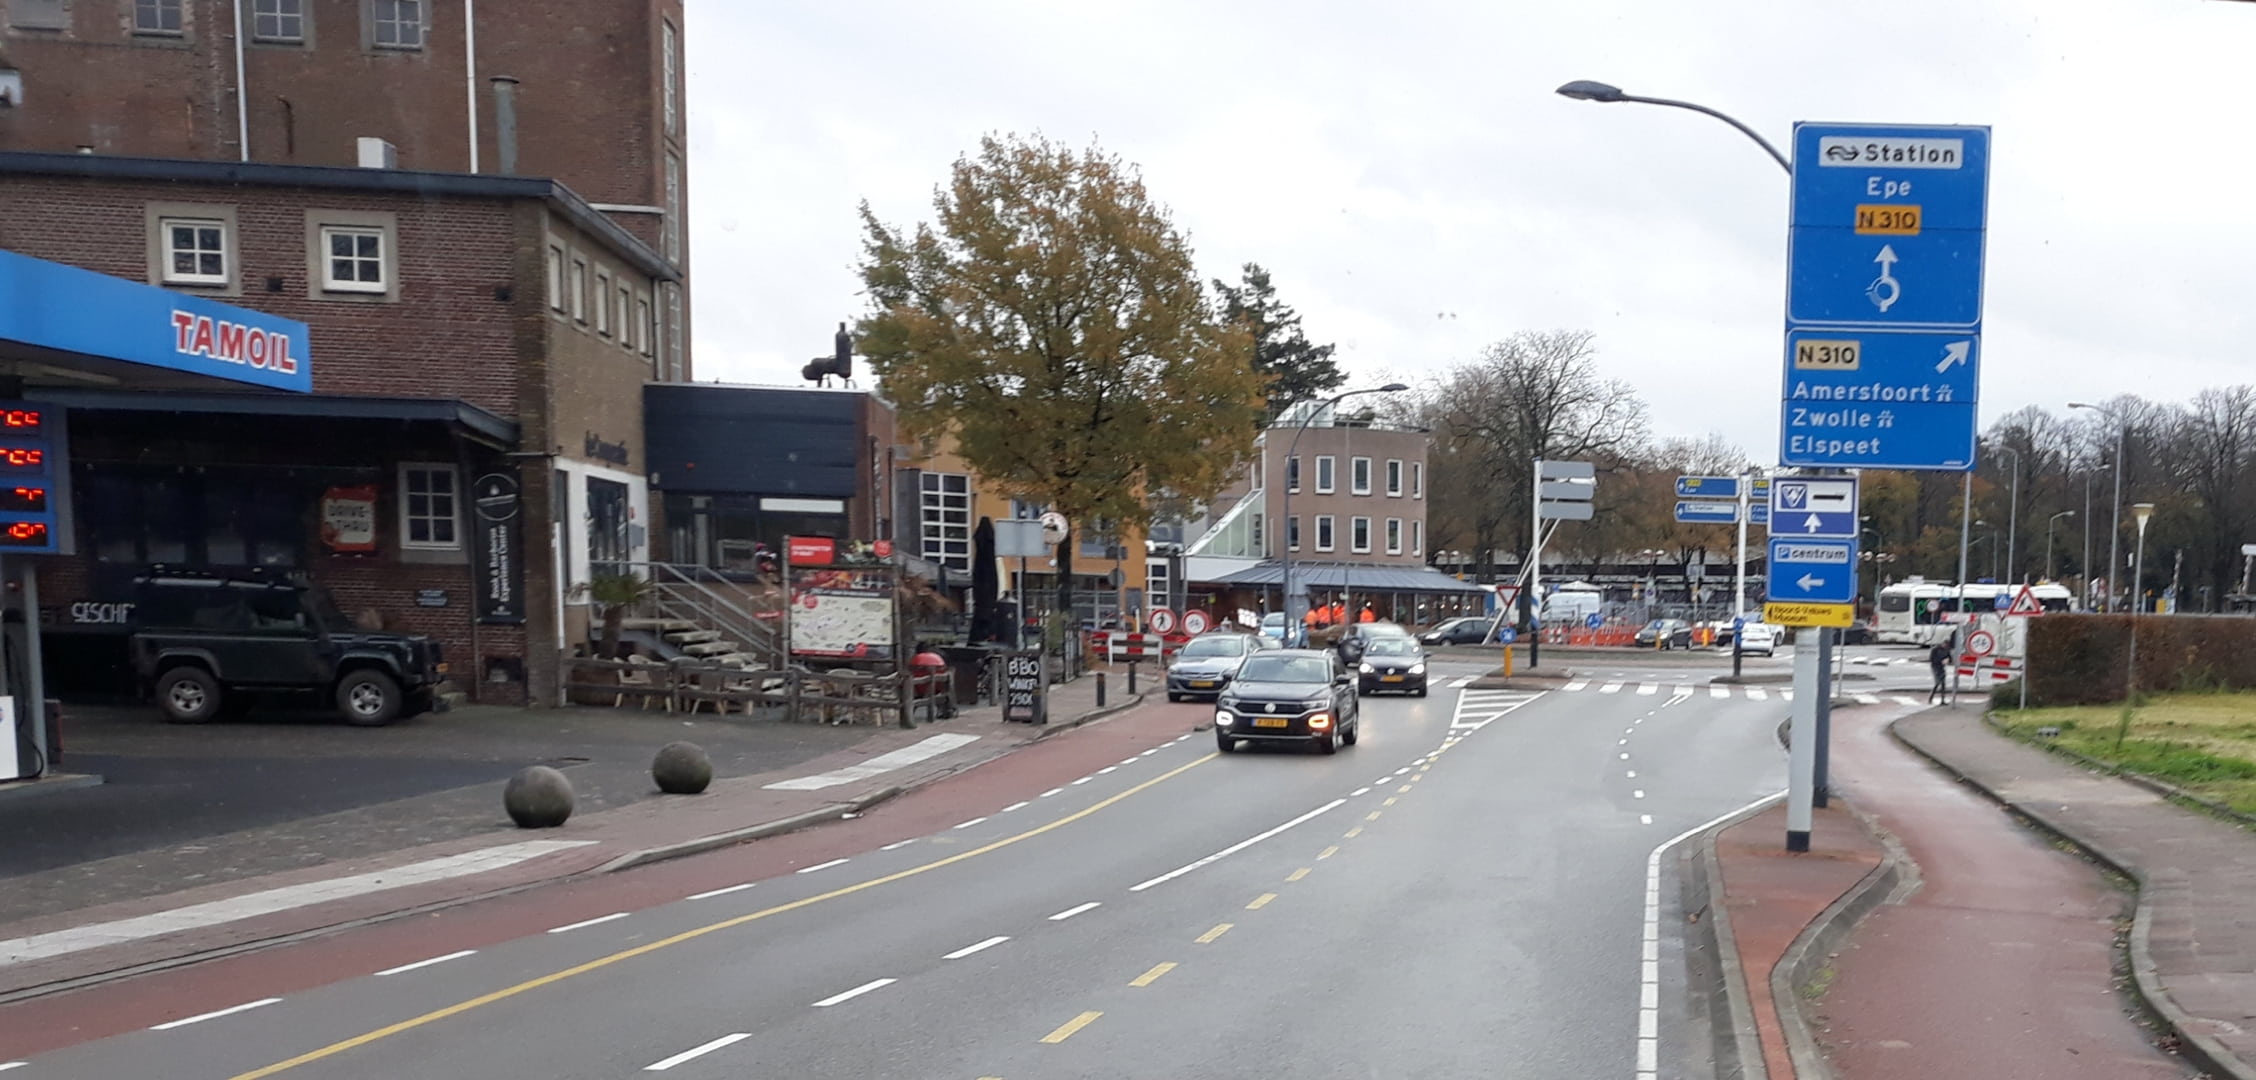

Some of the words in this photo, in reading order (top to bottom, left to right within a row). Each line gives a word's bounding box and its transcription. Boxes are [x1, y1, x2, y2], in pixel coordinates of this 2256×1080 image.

[1865, 144, 1955, 163] Station
[1867, 176, 1912, 199] Epe
[172, 309, 297, 375] TAMOIL
[1792, 381, 1931, 401] Amersfoort
[1791, 408, 1872, 428] Zwolle
[1790, 435, 1881, 456] Elspeet
[498, 524, 508, 554] Center
[1791, 546, 1846, 560] centrum
[498, 555, 511, 602] Experience
